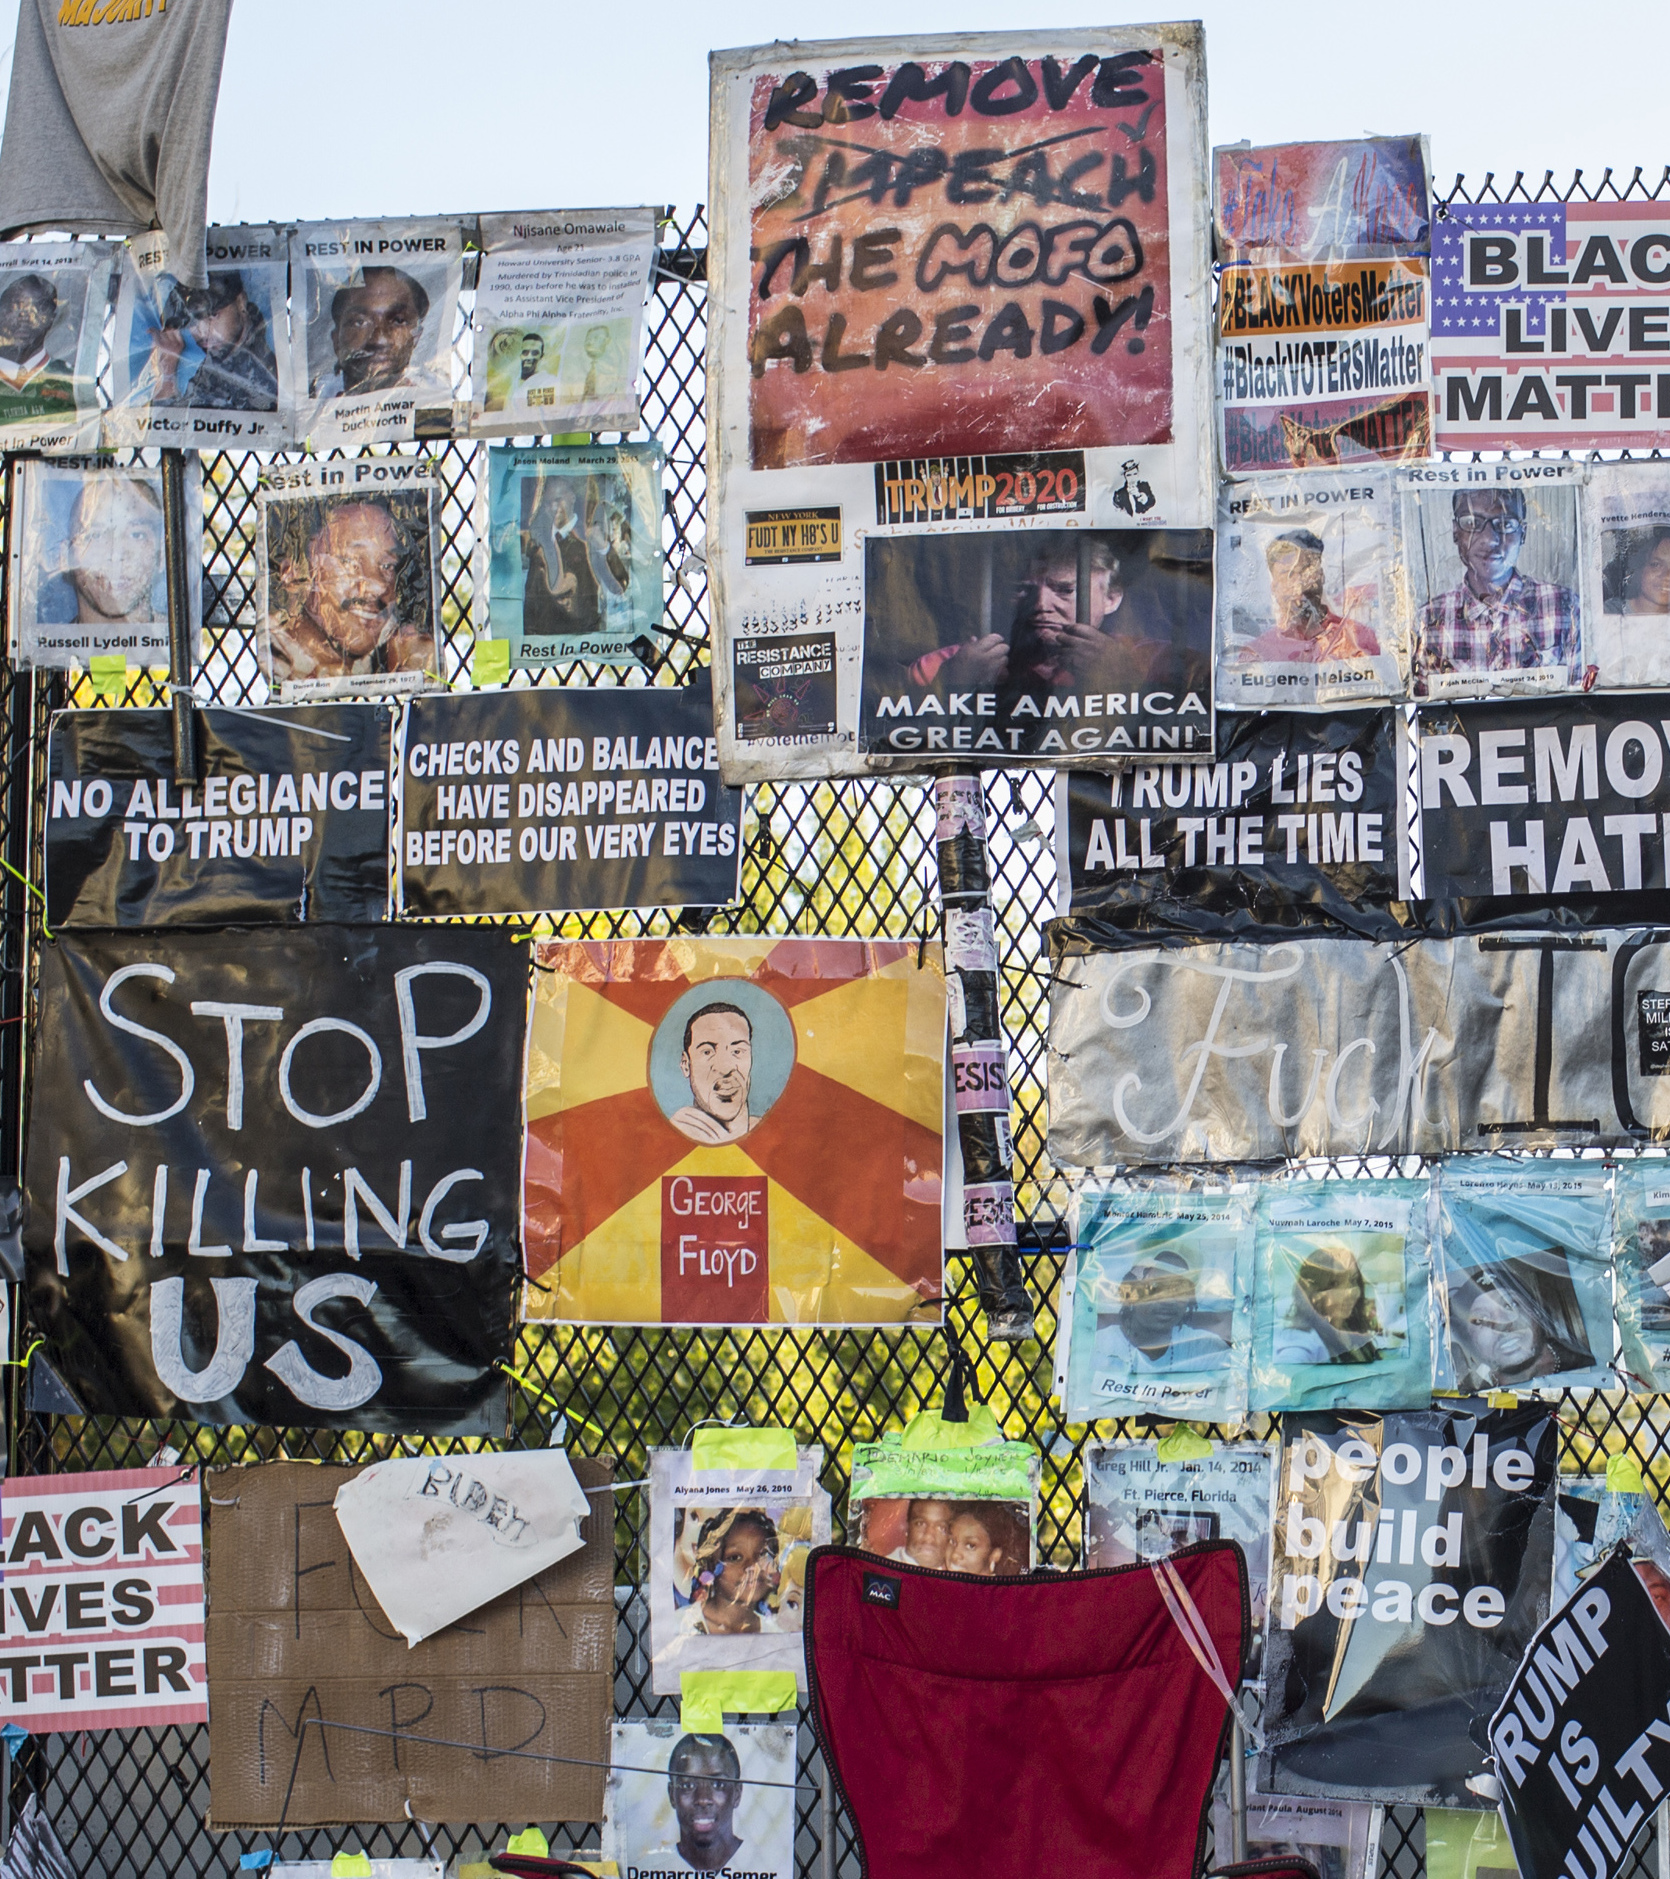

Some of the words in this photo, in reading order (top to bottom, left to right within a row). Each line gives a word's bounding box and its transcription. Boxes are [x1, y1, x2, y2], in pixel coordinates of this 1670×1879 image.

[765, 49, 1155, 130] REMOVE
[305, 241, 349, 257] REST
[354, 239, 376, 254] IN
[379, 237, 447, 254] POWER
[513, 224, 561, 240] Njisane
[564, 220, 627, 236] Omawale
[751, 228, 902, 300] THE
[915, 217, 1144, 291] MOFO
[751, 286, 1155, 379] ALREADY!
[137, 417, 189, 432] Victor
[193, 418, 243, 435] Duffy
[335, 405, 371, 420] Martin
[375, 400, 416, 412] Anwar
[342, 414, 408, 433] Duckworth
[1408, 467, 1460, 482] Rest
[1467, 466, 1487, 481] in
[1499, 465, 1566, 481] Power
[748, 526, 779, 549] FUDT
[782, 525, 798, 547] NY
[831, 523, 839, 544] U
[520, 644, 551, 658] Rest
[560, 643, 574, 657] In
[579, 640, 631, 655] Power
[736, 643, 832, 665] RESISTANCE
[759, 659, 832, 679] COMPANY
[1241, 670, 1310, 687] Eugene
[1315, 668, 1374, 685] Nelson
[876, 694, 998, 718] MAKE
[1010, 691, 1207, 717] AMERICA
[409, 738, 520, 777] CHECKS
[526, 737, 585, 774] AND
[889, 726, 1026, 753] GREAT
[1039, 723, 1195, 752] AGAIN!
[51, 780, 113, 819] NO
[124, 771, 387, 820] ALLEGIANCE
[436, 783, 511, 820] HAVE
[518, 778, 706, 818] DISAPPEARED
[1108, 762, 1258, 809] TRUMP
[1272, 751, 1364, 803] LIES
[123, 821, 175, 862] TO
[186, 817, 314, 859] TRUMP
[406, 828, 512, 866] BEFORE
[518, 826, 578, 863] OUR
[584, 822, 656, 859] VERY
[663, 821, 736, 857] EYES
[1084, 818, 1166, 871] ALL
[1176, 815, 1265, 867] THE
[1277, 812, 1385, 865] TIME
[84, 961, 492, 1130] STOP
[55, 1156, 489, 1278] KILLING
[678, 1235, 758, 1288] FLOYD
[149, 1272, 383, 1411] US
[1097, 1460, 1126, 1474] Greg
[1130, 1460, 1151, 1472] Hill
[1154, 1461, 1169, 1473] Jr.
[1180, 1461, 1205, 1473] Jan.
[1209, 1461, 1226, 1475] 14,
[1230, 1461, 1262, 1474] 2014
[1288, 1433, 1536, 1502] people
[1124, 1489, 1140, 1501] Ft.
[1145, 1489, 1186, 1503] Pierce,
[1191, 1490, 1238, 1503] Florida
[0, 1501, 178, 1563] ACK
[1284, 1503, 1464, 1568] build
[869, 1589, 892, 1602] MAC
[1280, 1573, 1507, 1631] peace
[1547, 1719, 1600, 1811] IS
